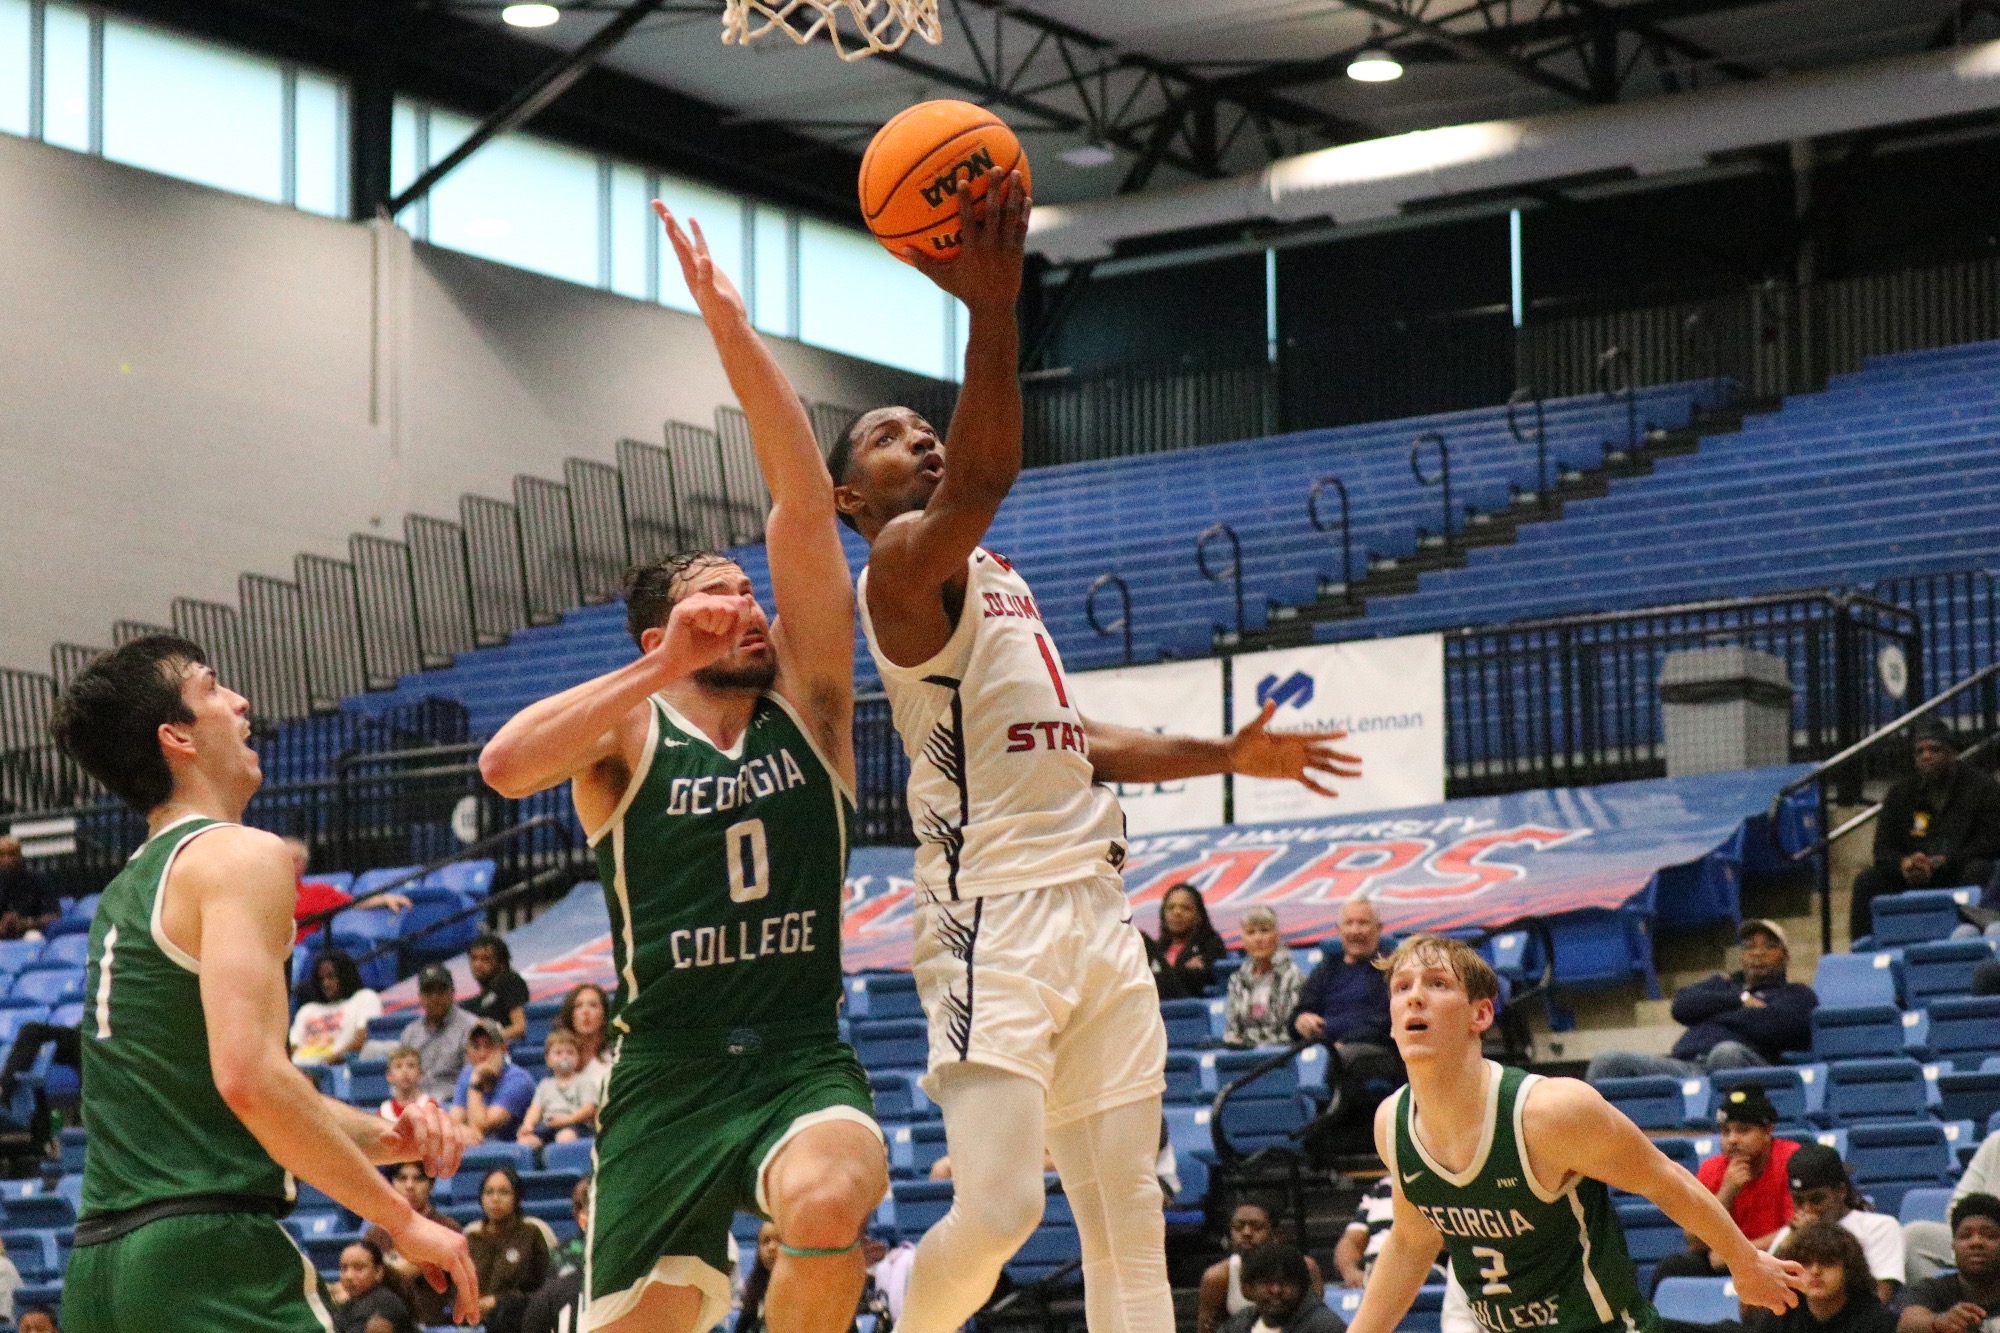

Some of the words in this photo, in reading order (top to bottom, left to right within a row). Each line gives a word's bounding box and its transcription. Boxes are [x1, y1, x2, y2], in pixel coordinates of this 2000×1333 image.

[1034, 632, 1069, 708] 1
[1006, 721, 1085, 753] STAT
[666, 749, 807, 816] GEORGIA
[726, 818, 770, 903] 0
[671, 910, 817, 969] COLLEGE
[1418, 1205, 1536, 1239] GEORGIA
[1467, 1294, 1560, 1333] OLLEGE
